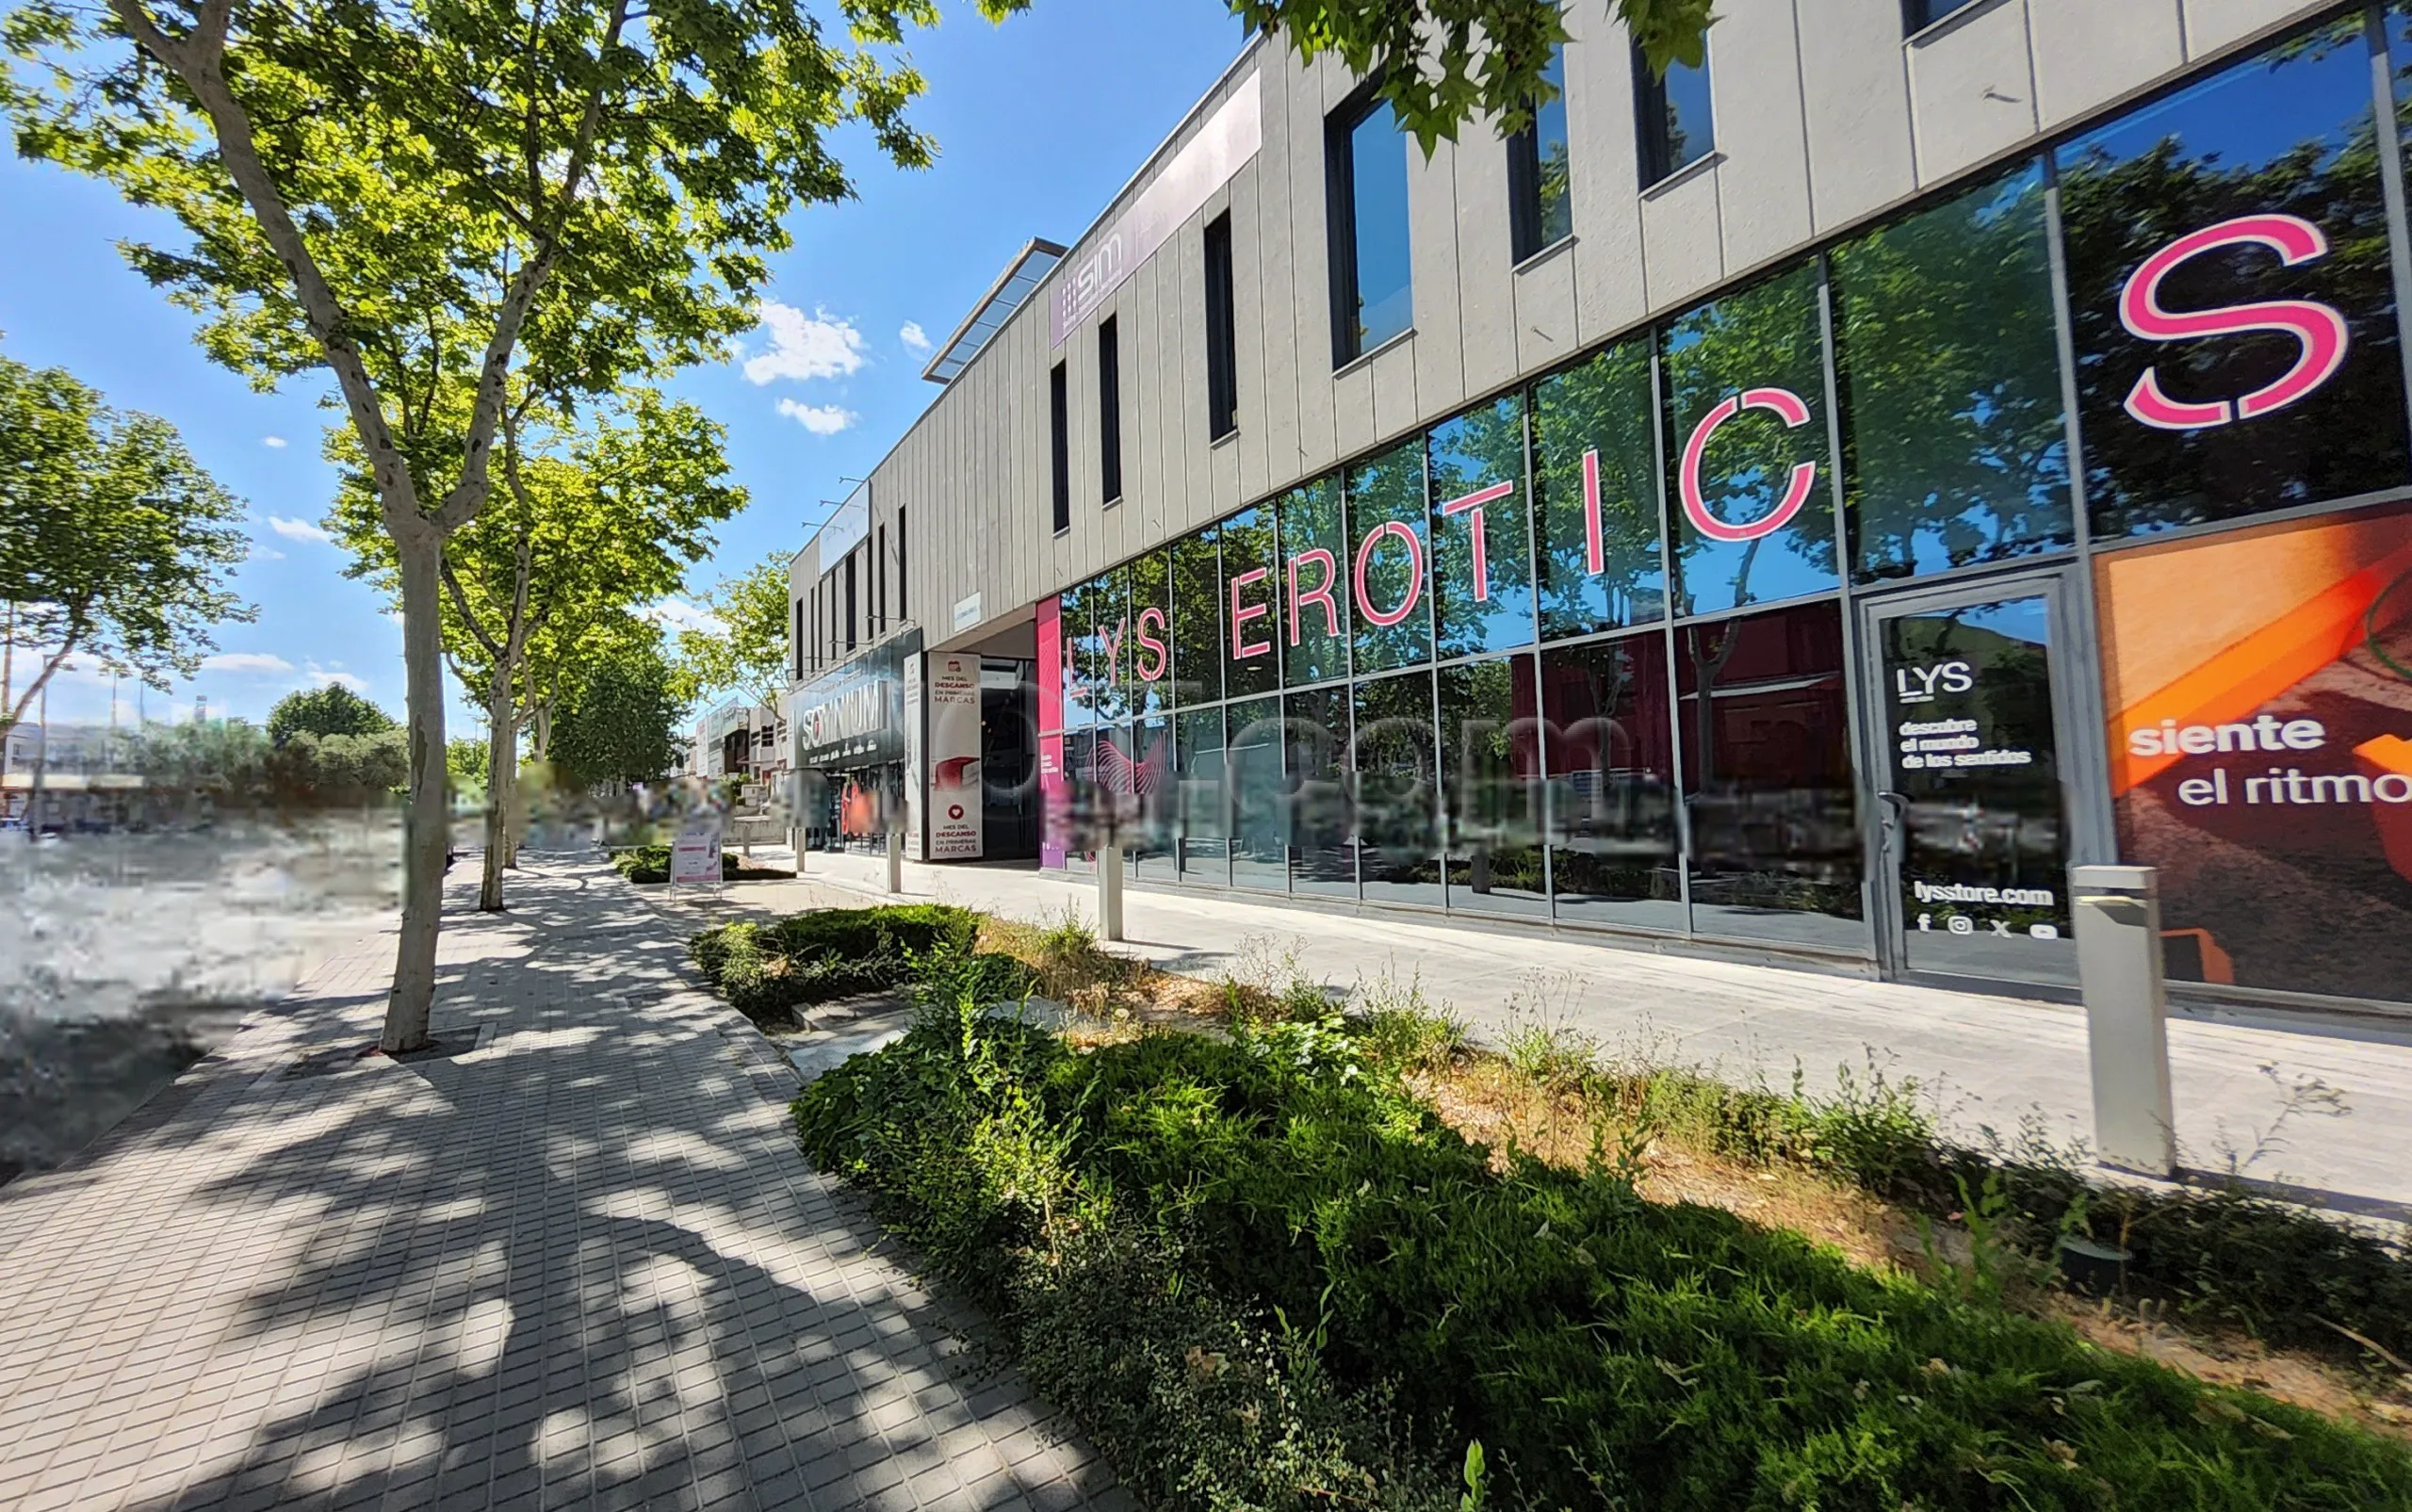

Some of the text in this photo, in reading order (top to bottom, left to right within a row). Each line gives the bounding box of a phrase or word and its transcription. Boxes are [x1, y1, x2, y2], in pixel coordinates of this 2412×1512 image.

[1067, 213, 2349, 698] LYS EROTIC S
[1897, 661, 1973, 697] LYS
[934, 696, 976, 705] MARCAS
[1899, 718, 1978, 736] descubre
[2128, 715, 2325, 756] siente
[1900, 738, 1917, 753] el
[1901, 749, 2032, 769] de los sentidos
[2177, 768, 2412, 805] el ritmo
[1914, 881, 2055, 906] lysstore.com
